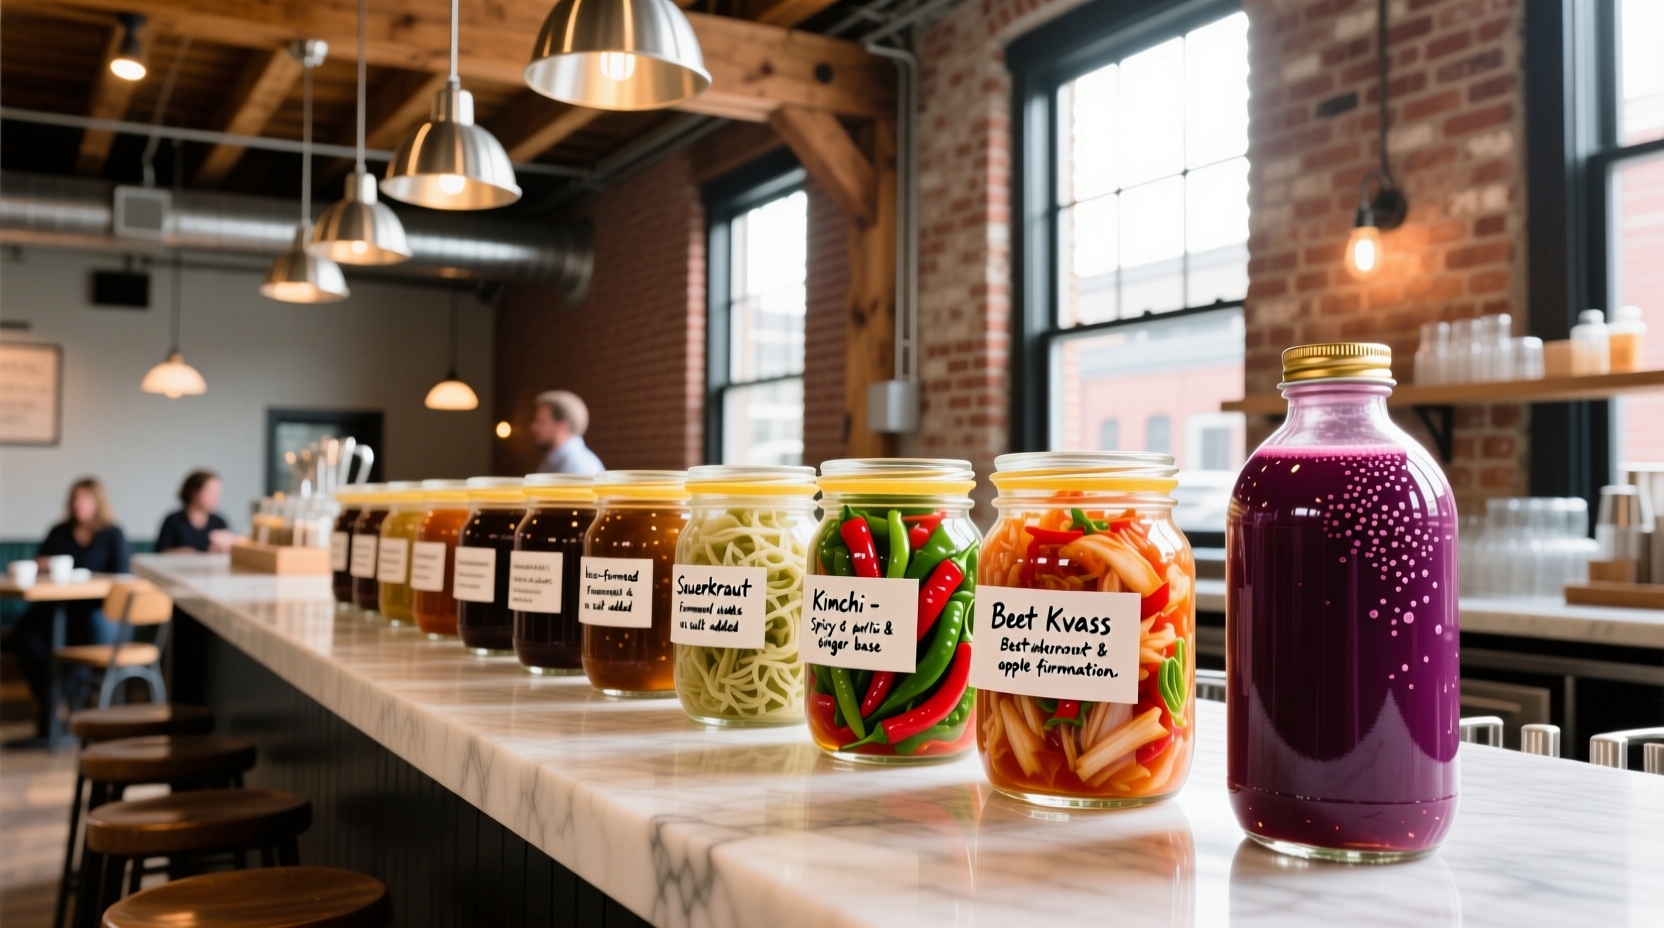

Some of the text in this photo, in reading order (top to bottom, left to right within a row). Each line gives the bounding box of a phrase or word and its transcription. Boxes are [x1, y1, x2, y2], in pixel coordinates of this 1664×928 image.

[812, 588, 866, 613] Kimchi
[883, 620, 894, 636] &
[991, 601, 1112, 636] Beet Kvass
[1096, 641, 1109, 658] &
[997, 657, 1032, 679] apple
